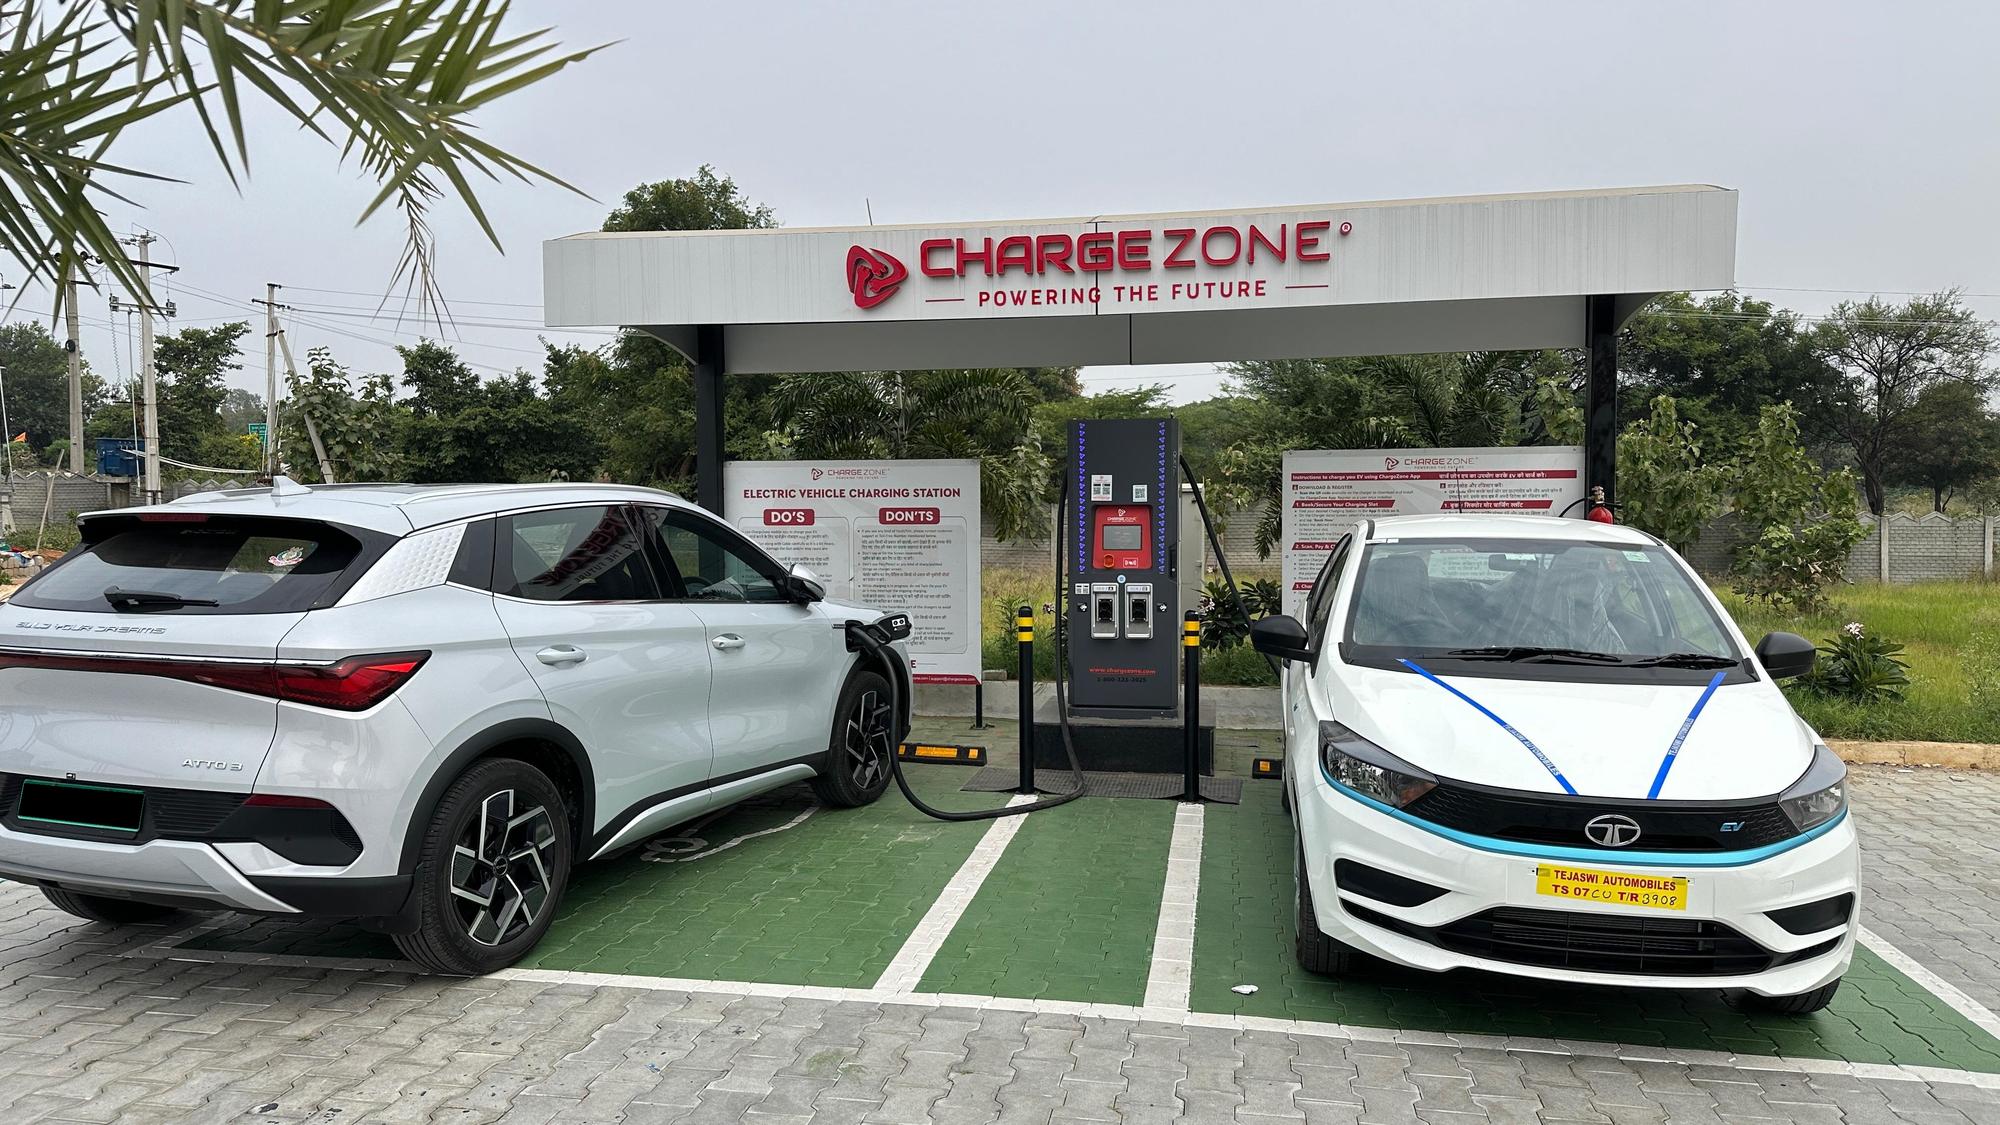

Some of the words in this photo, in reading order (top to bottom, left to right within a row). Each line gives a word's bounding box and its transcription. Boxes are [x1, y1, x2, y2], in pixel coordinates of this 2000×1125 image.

[978, 286, 1101, 307] POWERING
[1113, 284, 1159, 302] THE
[1171, 280, 1267, 300] FUTURE
[744, 489, 796, 499] ELECTRIC
[799, 489, 846, 498] VEHICLE
[849, 488, 909, 498] CHARGING
[913, 488, 960, 498] STATION
[885, 510, 934, 522] DON'TS
[54, 623, 93, 632] YOUR
[94, 625, 167, 634] DREAMS
[182, 758, 228, 770] ATTO
[230, 762, 244, 772] 3
[1720, 821, 1745, 832] EV
[1554, 870, 1598, 884] TEJASWI
[1602, 876, 1676, 891] AUTOMOBILES
[1552, 884, 1569, 894] TS
